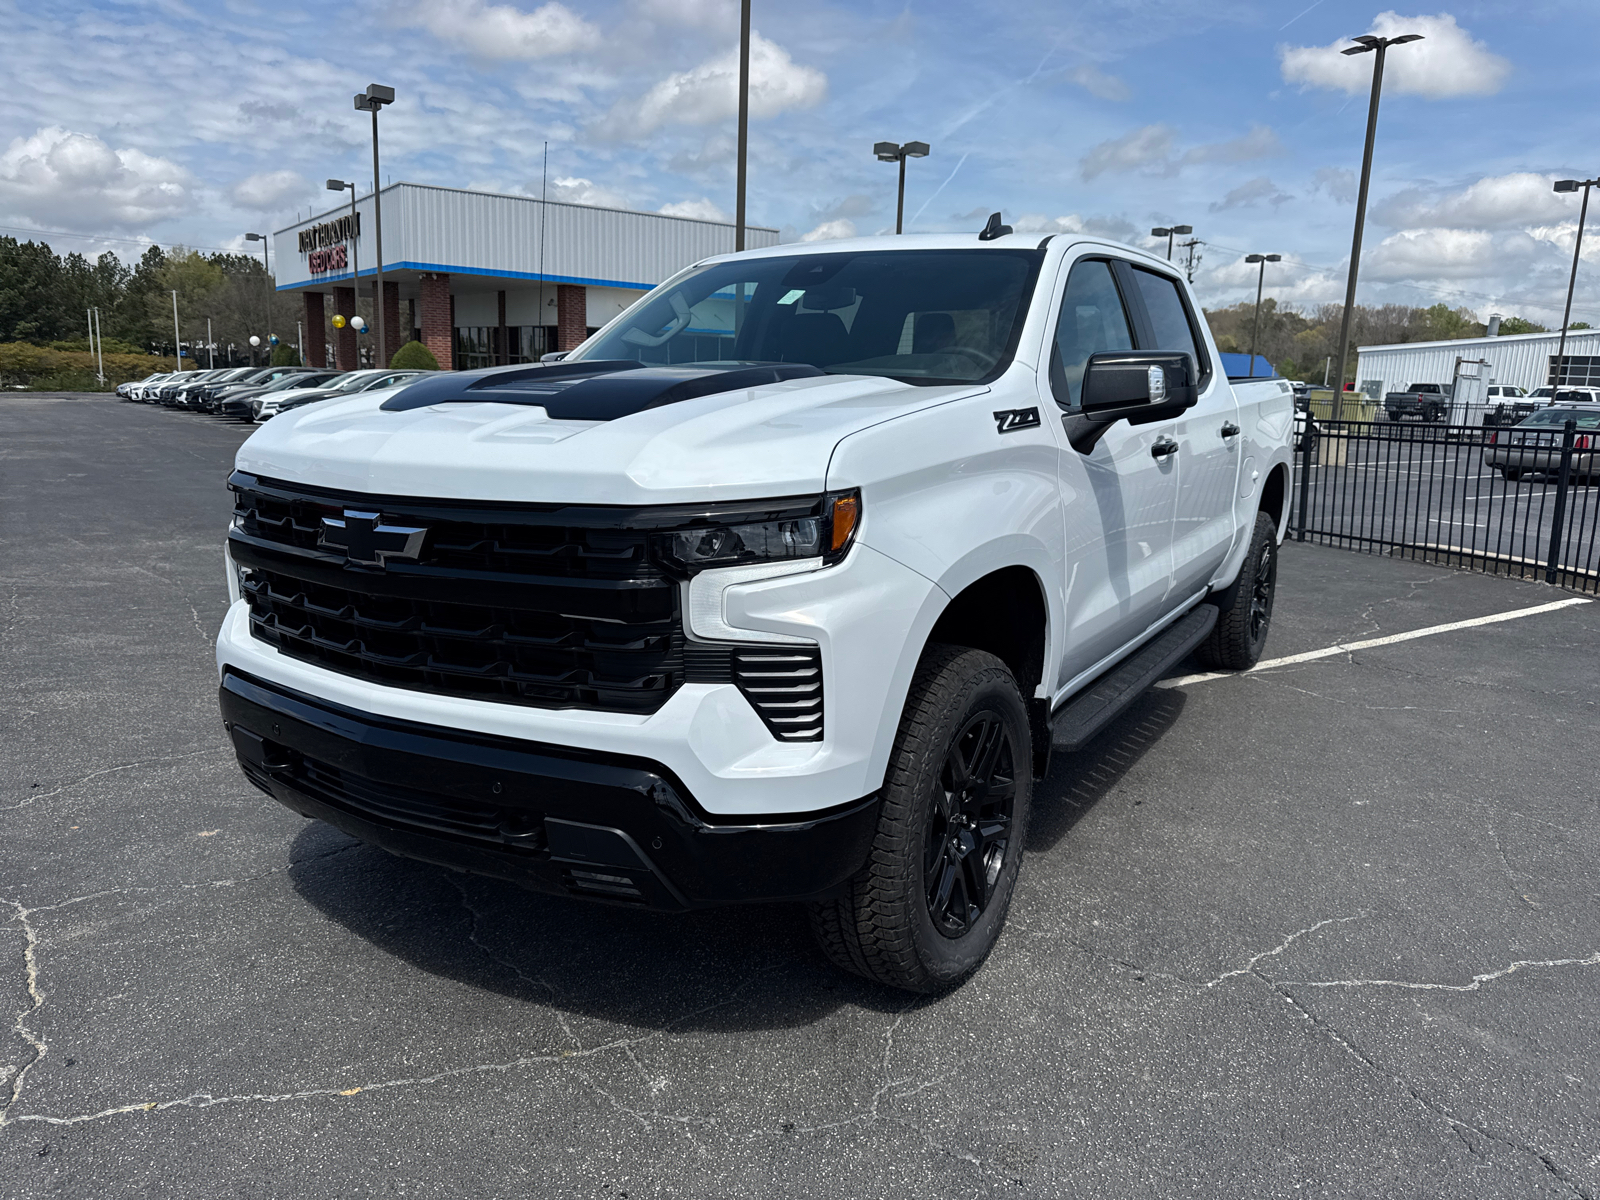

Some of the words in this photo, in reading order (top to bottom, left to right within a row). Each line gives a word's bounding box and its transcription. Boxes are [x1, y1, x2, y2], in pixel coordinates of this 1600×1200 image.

[298, 226, 317, 253] JOHN
[308, 250, 327, 274] USED
[326, 244, 348, 271] CARS
[993, 406, 1041, 435] Z71
